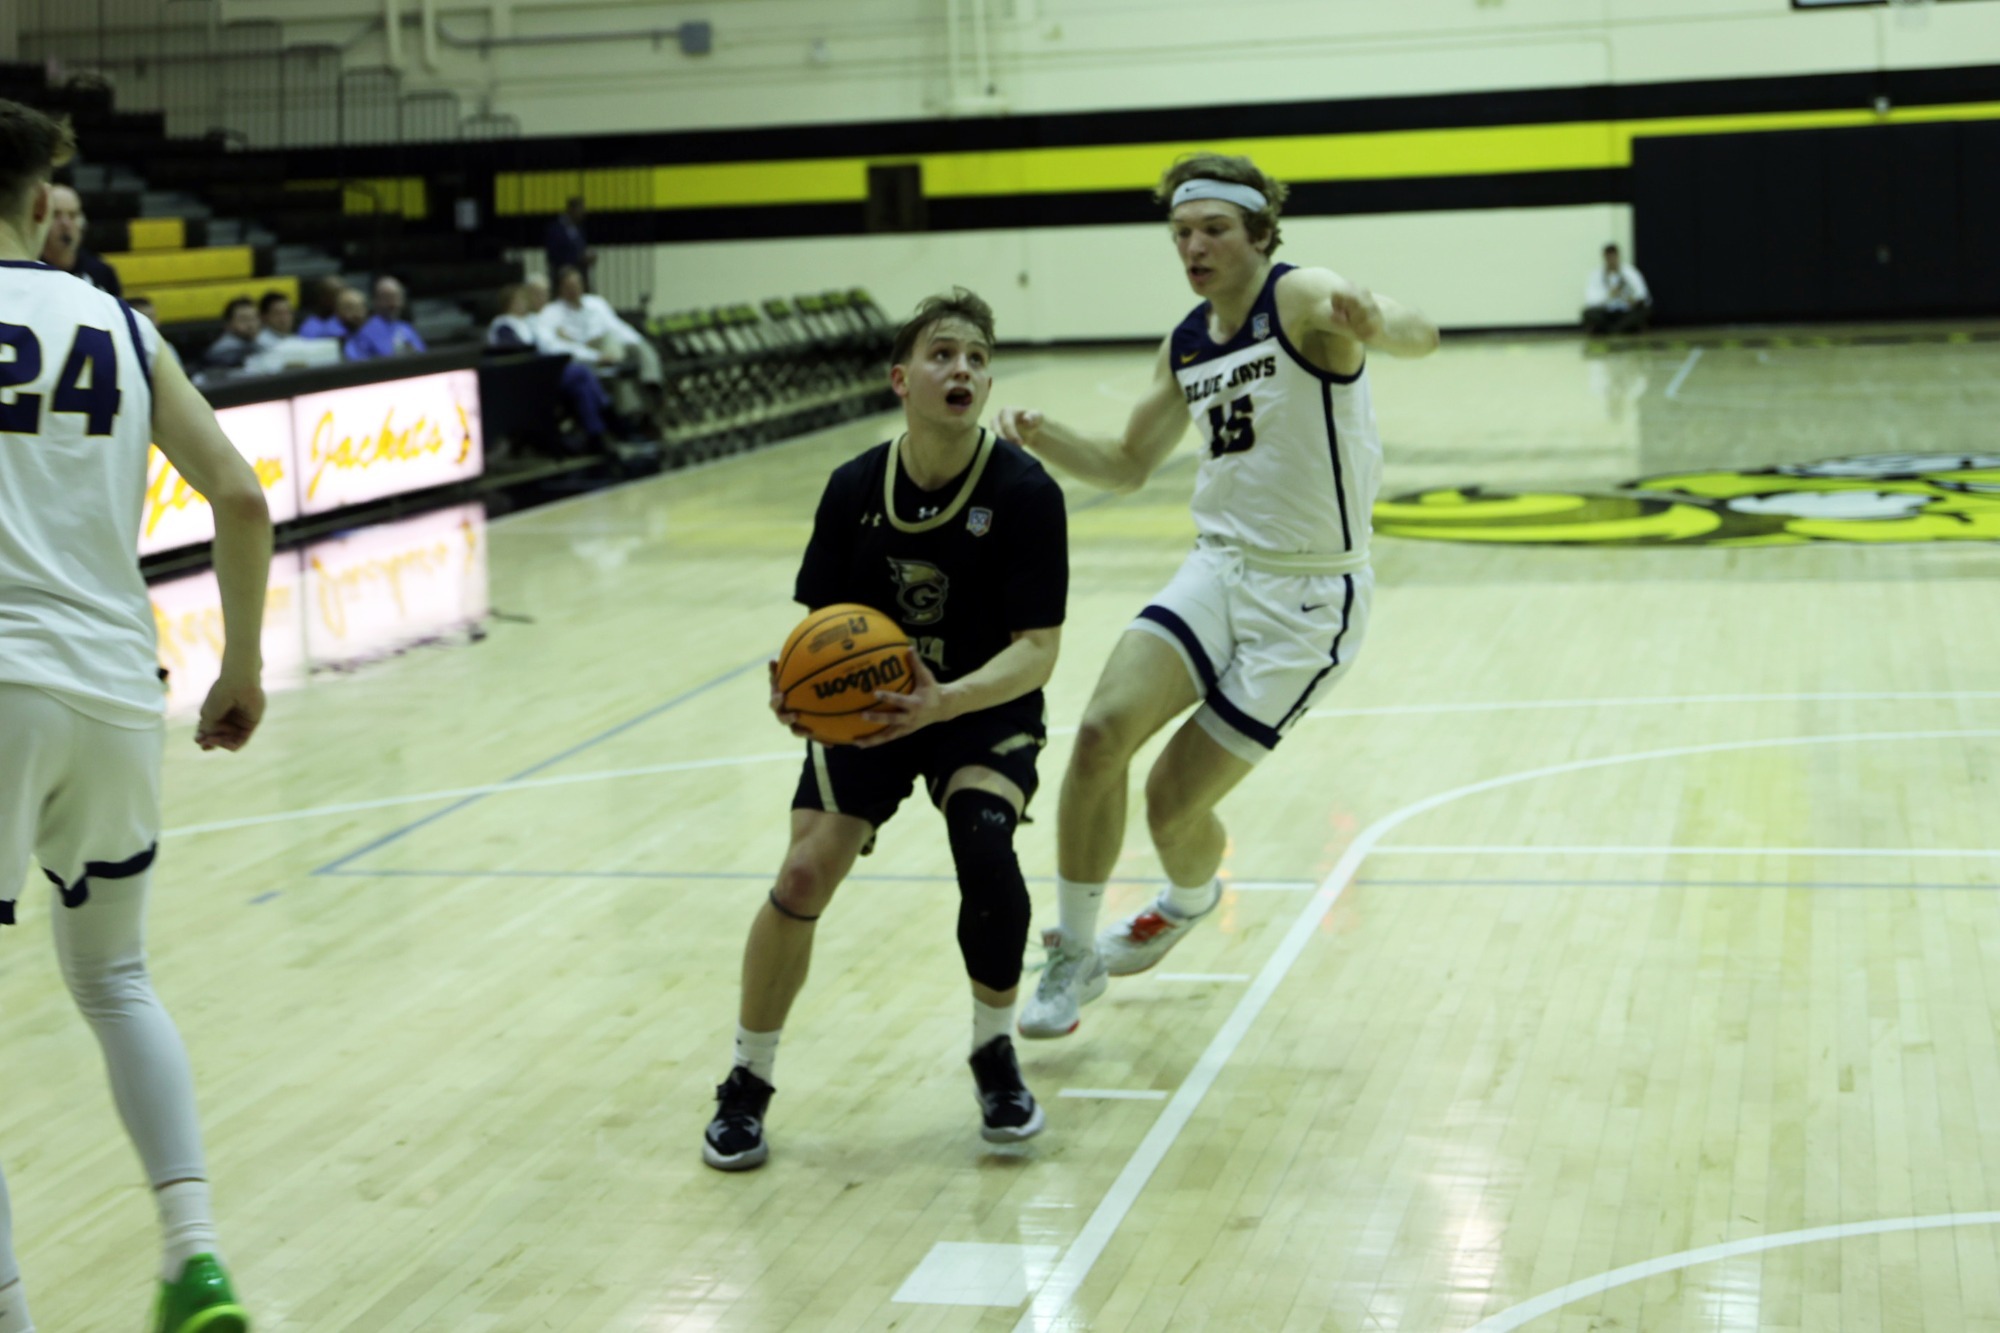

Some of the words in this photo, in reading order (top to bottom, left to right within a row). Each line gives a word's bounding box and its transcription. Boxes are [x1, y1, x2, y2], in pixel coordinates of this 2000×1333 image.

[0, 322, 122, 437] 24
[1185, 373, 1223, 405] BLUE
[1227, 355, 1276, 388] JAYS
[1208, 393, 1254, 460] 15
[812, 654, 905, 699] Wilson
